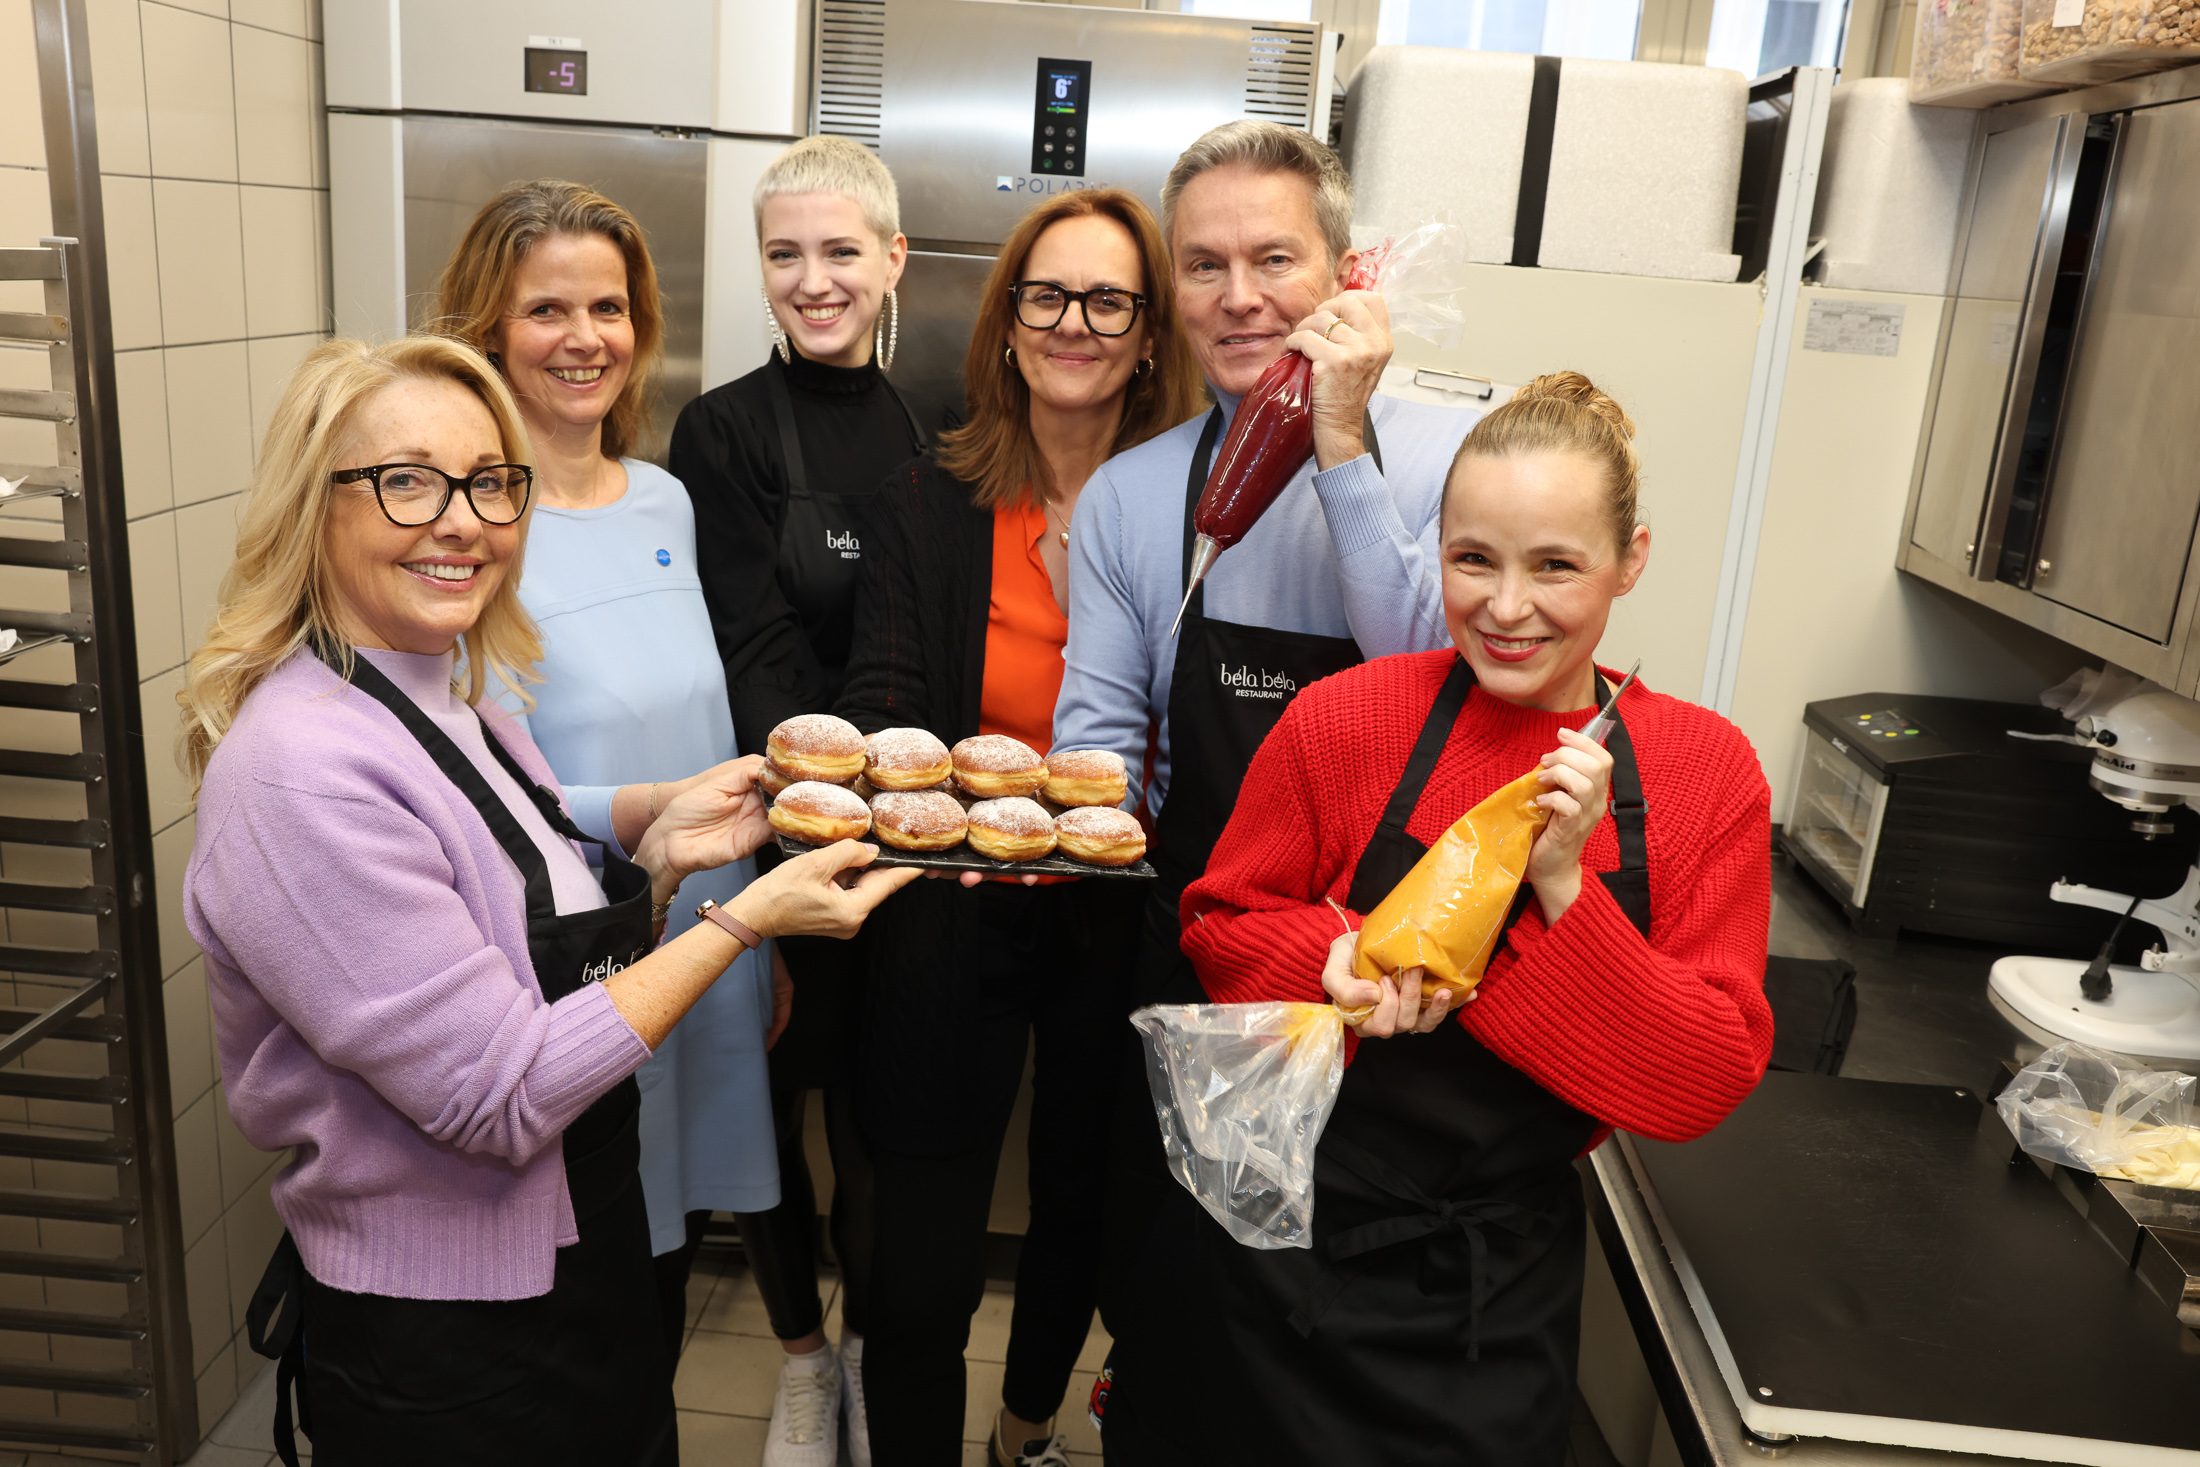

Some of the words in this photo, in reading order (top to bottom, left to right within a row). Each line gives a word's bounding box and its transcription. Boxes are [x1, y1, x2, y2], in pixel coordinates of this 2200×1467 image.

[549, 62, 575, 87] -5
[826, 529, 861, 550] béla
[1221, 663, 1258, 687] béla
[1262, 668, 1296, 692] béla
[1235, 689, 1284, 700] RESTAURANT
